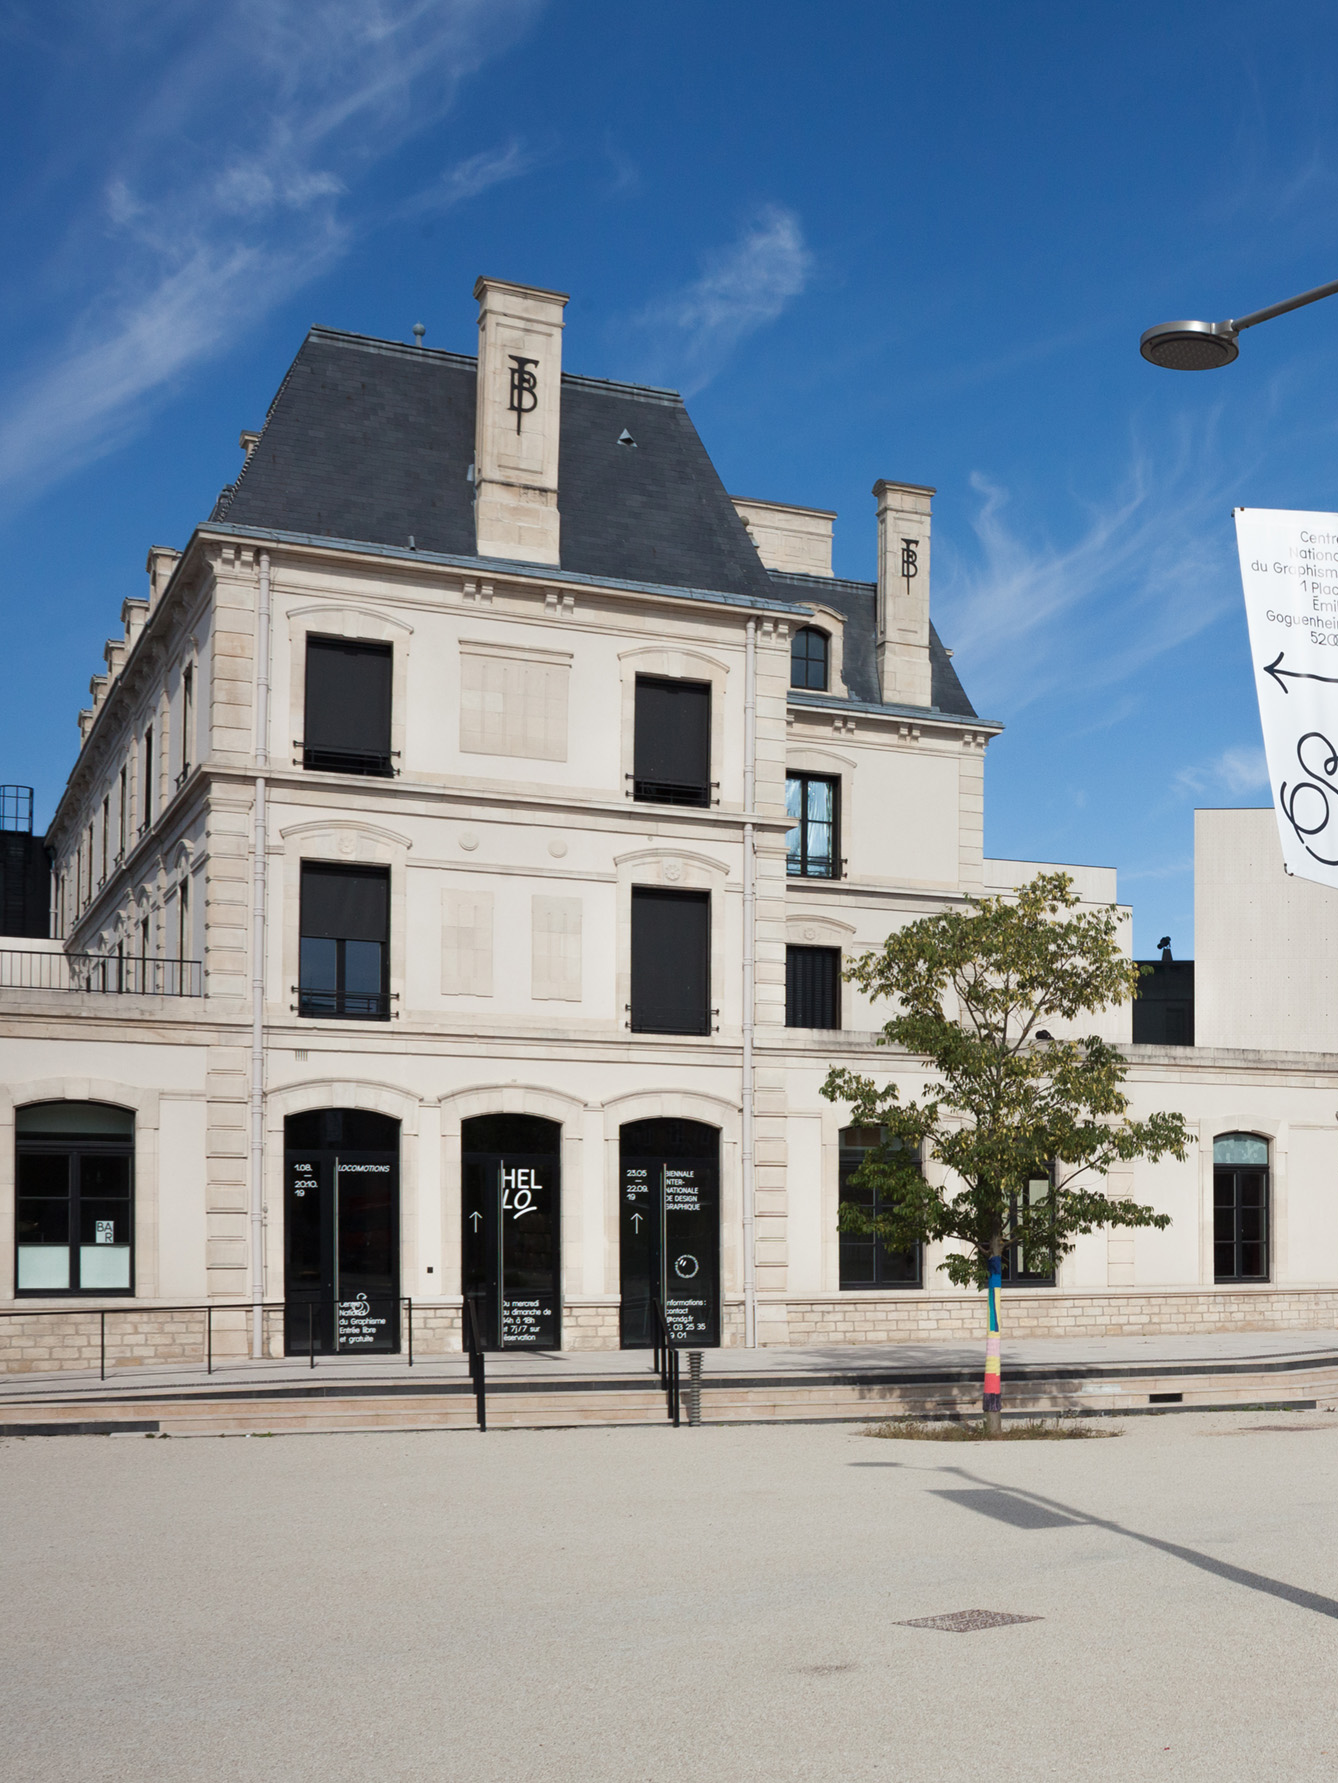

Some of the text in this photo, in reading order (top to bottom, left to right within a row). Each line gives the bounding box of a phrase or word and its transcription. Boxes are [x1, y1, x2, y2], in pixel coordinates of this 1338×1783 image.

[1251, 560, 1267, 572] du
[1300, 580, 1307, 592] 1
[502, 1168, 543, 1189] HEL
[503, 1189, 532, 1210] LO
[350, 1317, 386, 1326] Graphisme
[348, 1335, 374, 1344] gratuite
